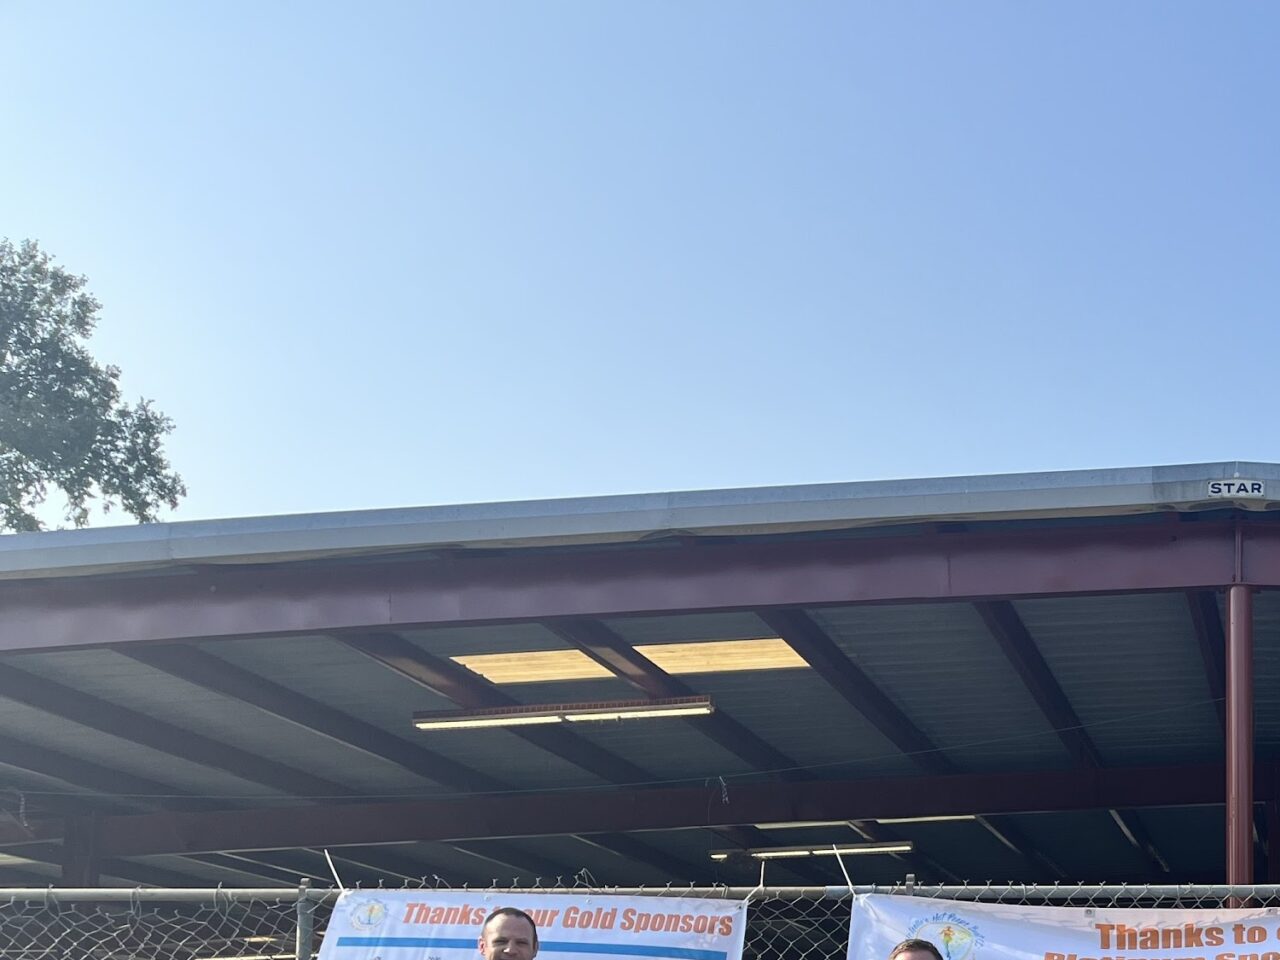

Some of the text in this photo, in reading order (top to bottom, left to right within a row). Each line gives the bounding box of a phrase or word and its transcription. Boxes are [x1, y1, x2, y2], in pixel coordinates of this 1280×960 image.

[1210, 482, 1262, 494] STAR
[402, 903, 487, 926] Thanks
[562, 906, 616, 929] Gold
[620, 907, 733, 936] Sponsors
[1095, 922, 1224, 950] Thanks
[1232, 923, 1267, 945] to
